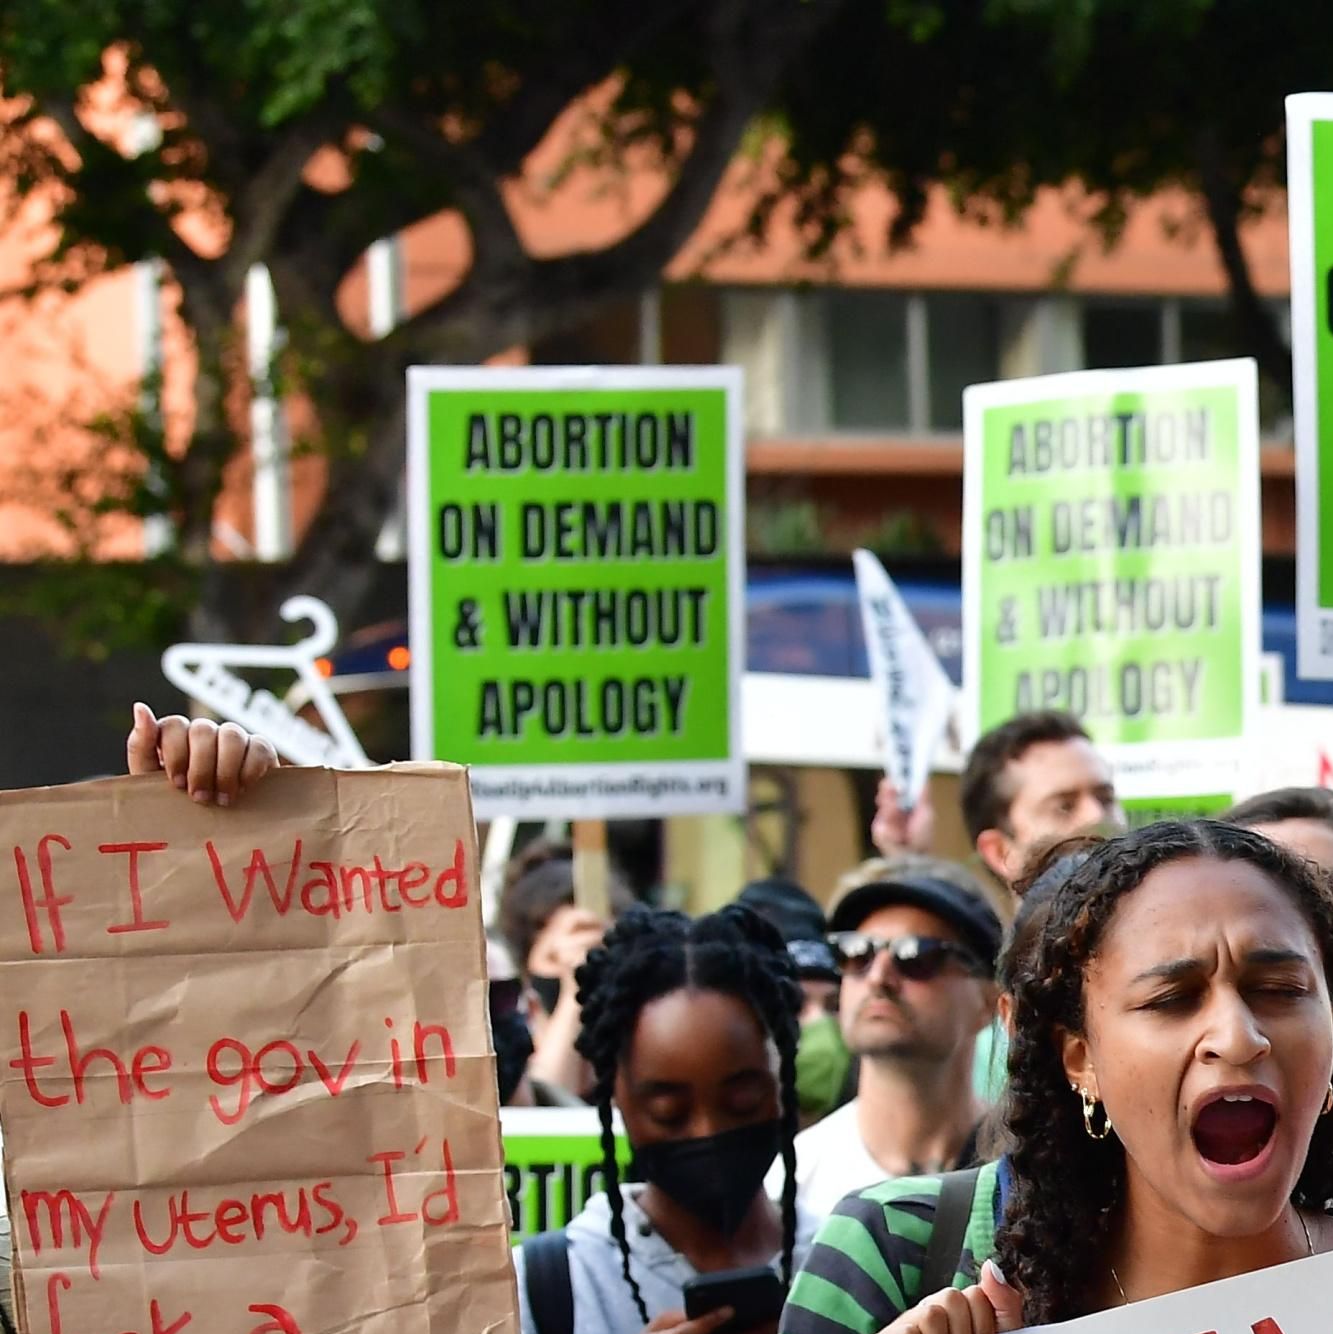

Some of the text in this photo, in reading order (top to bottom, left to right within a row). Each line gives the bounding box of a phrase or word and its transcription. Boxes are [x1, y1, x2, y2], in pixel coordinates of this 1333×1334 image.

[464, 411, 694, 471] ABORTION
[1008, 409, 1209, 476] ABORTION
[438, 499, 718, 560] ON DEMAND
[985, 491, 1232, 560] ON DEMAND
[452, 586, 710, 652] & WITHOUT
[1037, 576, 1221, 639] WITHOUT
[475, 674, 689, 739] APOLOGY
[1014, 656, 1204, 720] APOLOGY
[13, 833, 469, 954] If I Wanted
[9, 1008, 456, 1126] the gov in
